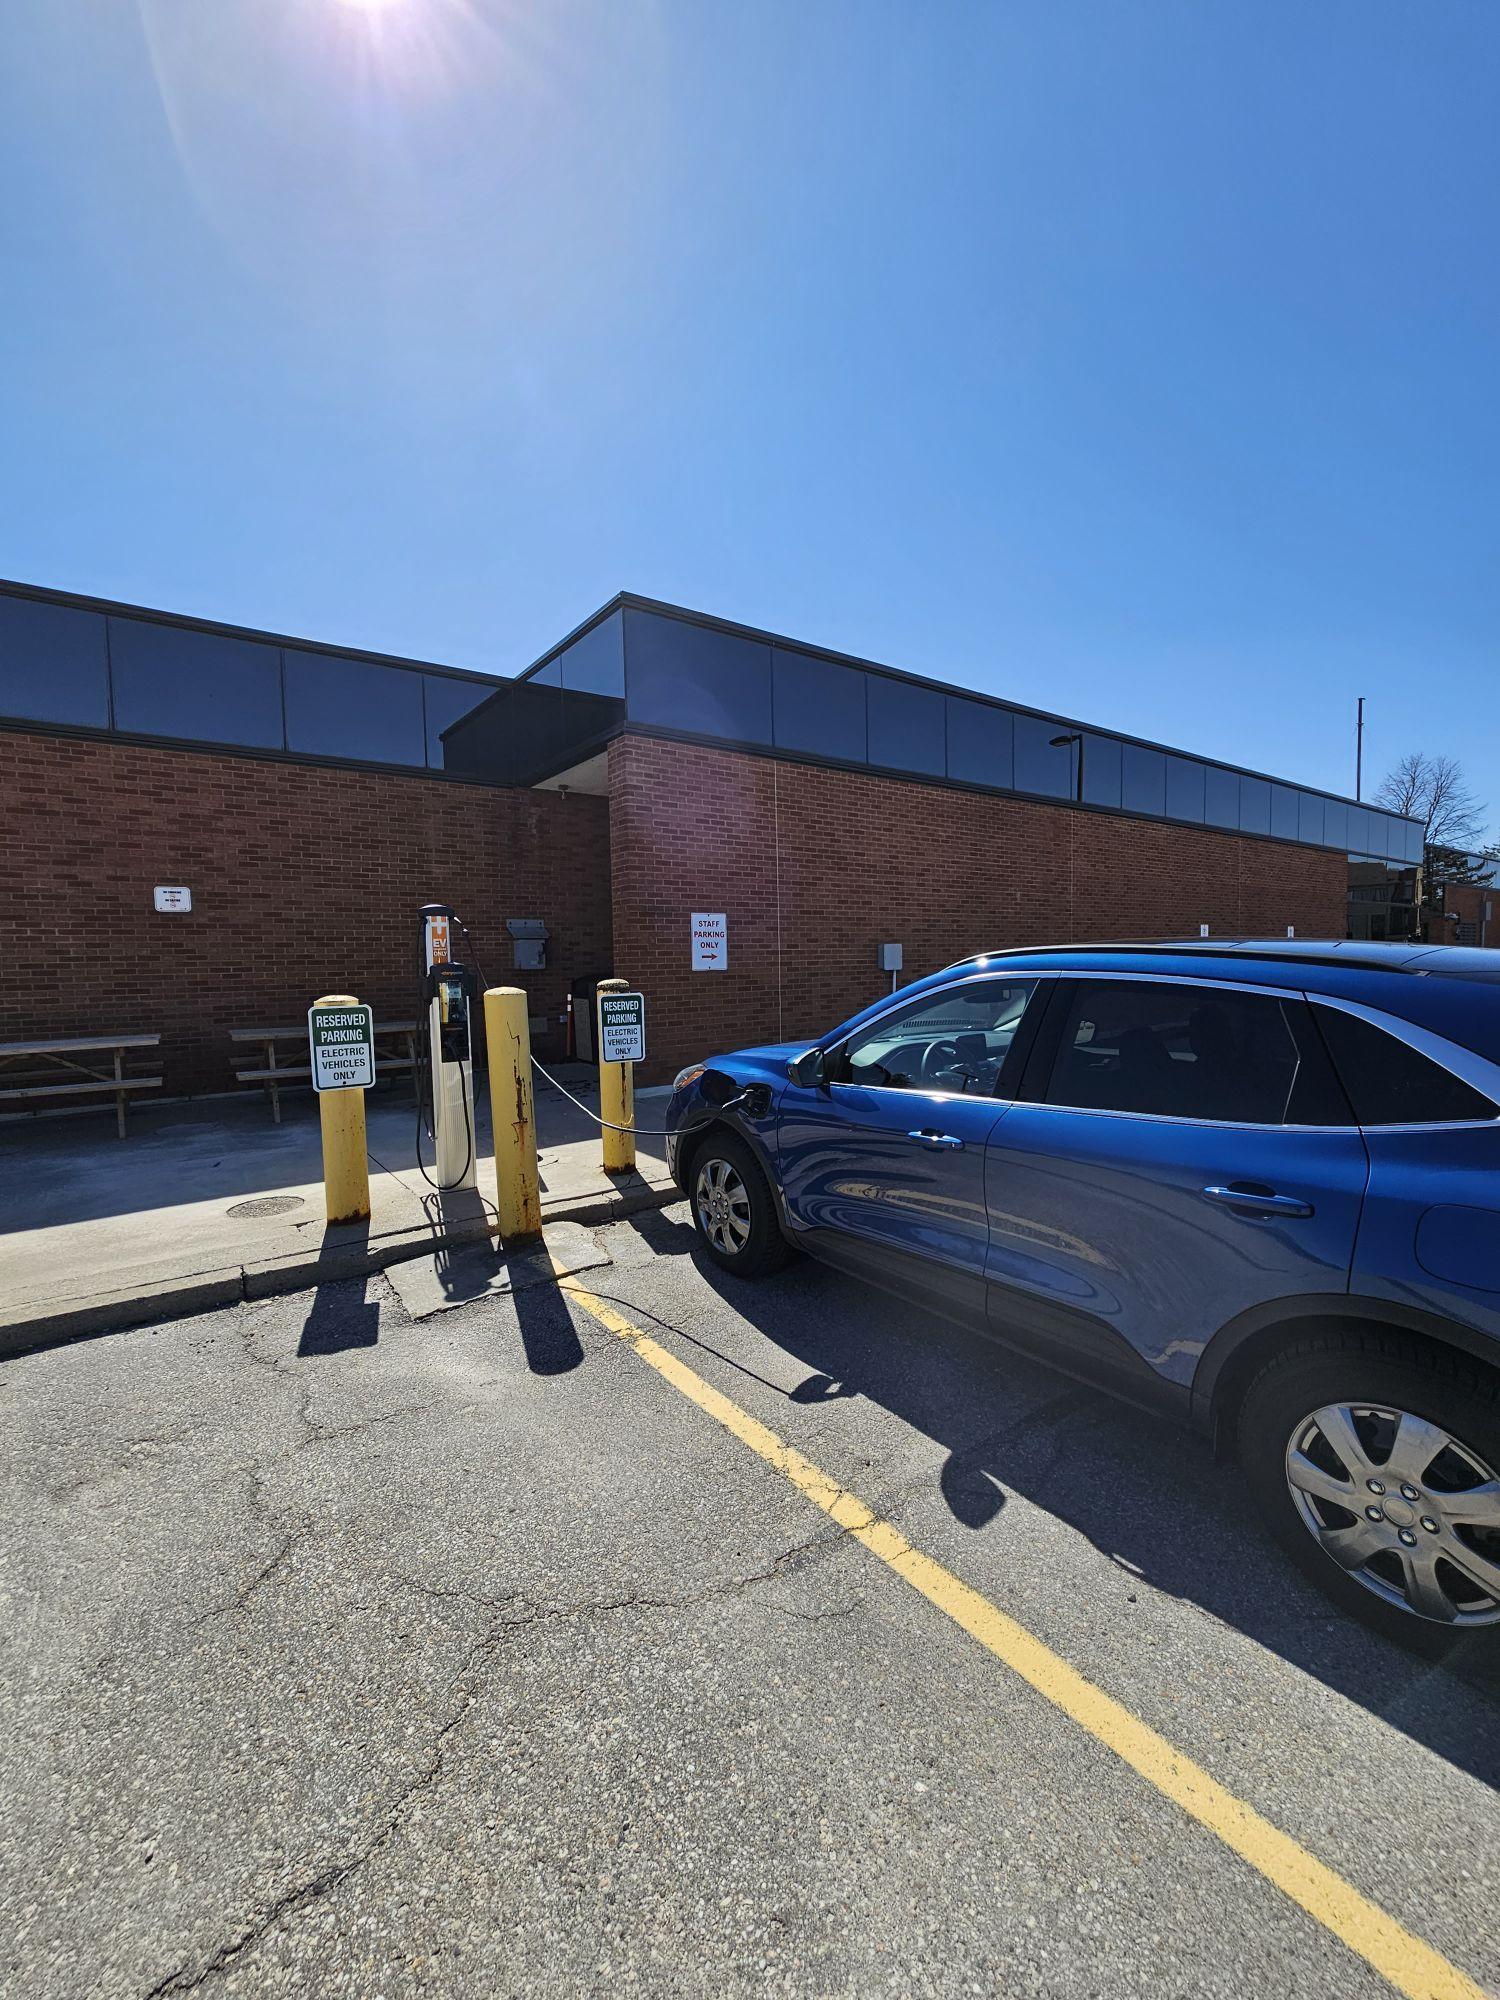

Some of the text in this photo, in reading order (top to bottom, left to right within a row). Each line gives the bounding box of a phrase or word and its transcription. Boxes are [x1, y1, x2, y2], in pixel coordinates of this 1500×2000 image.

[698, 920, 720, 928] STAFF
[433, 938, 447, 948] EV
[700, 941, 719, 949] ONLY
[603, 1000, 639, 1012] RESERVED
[316, 1013, 366, 1028] RESERVED
[607, 1013, 637, 1024] PARKING
[320, 1028, 363, 1043] PARKING
[607, 1027, 638, 1037] ELECTRIC
[607, 1037, 638, 1046] VEHICLES
[321, 1047, 365, 1058] ELECTRIC
[615, 1047, 632, 1055] ONLY
[322, 1058, 366, 1070] VEHICLES
[333, 1070, 356, 1081] ONLY
